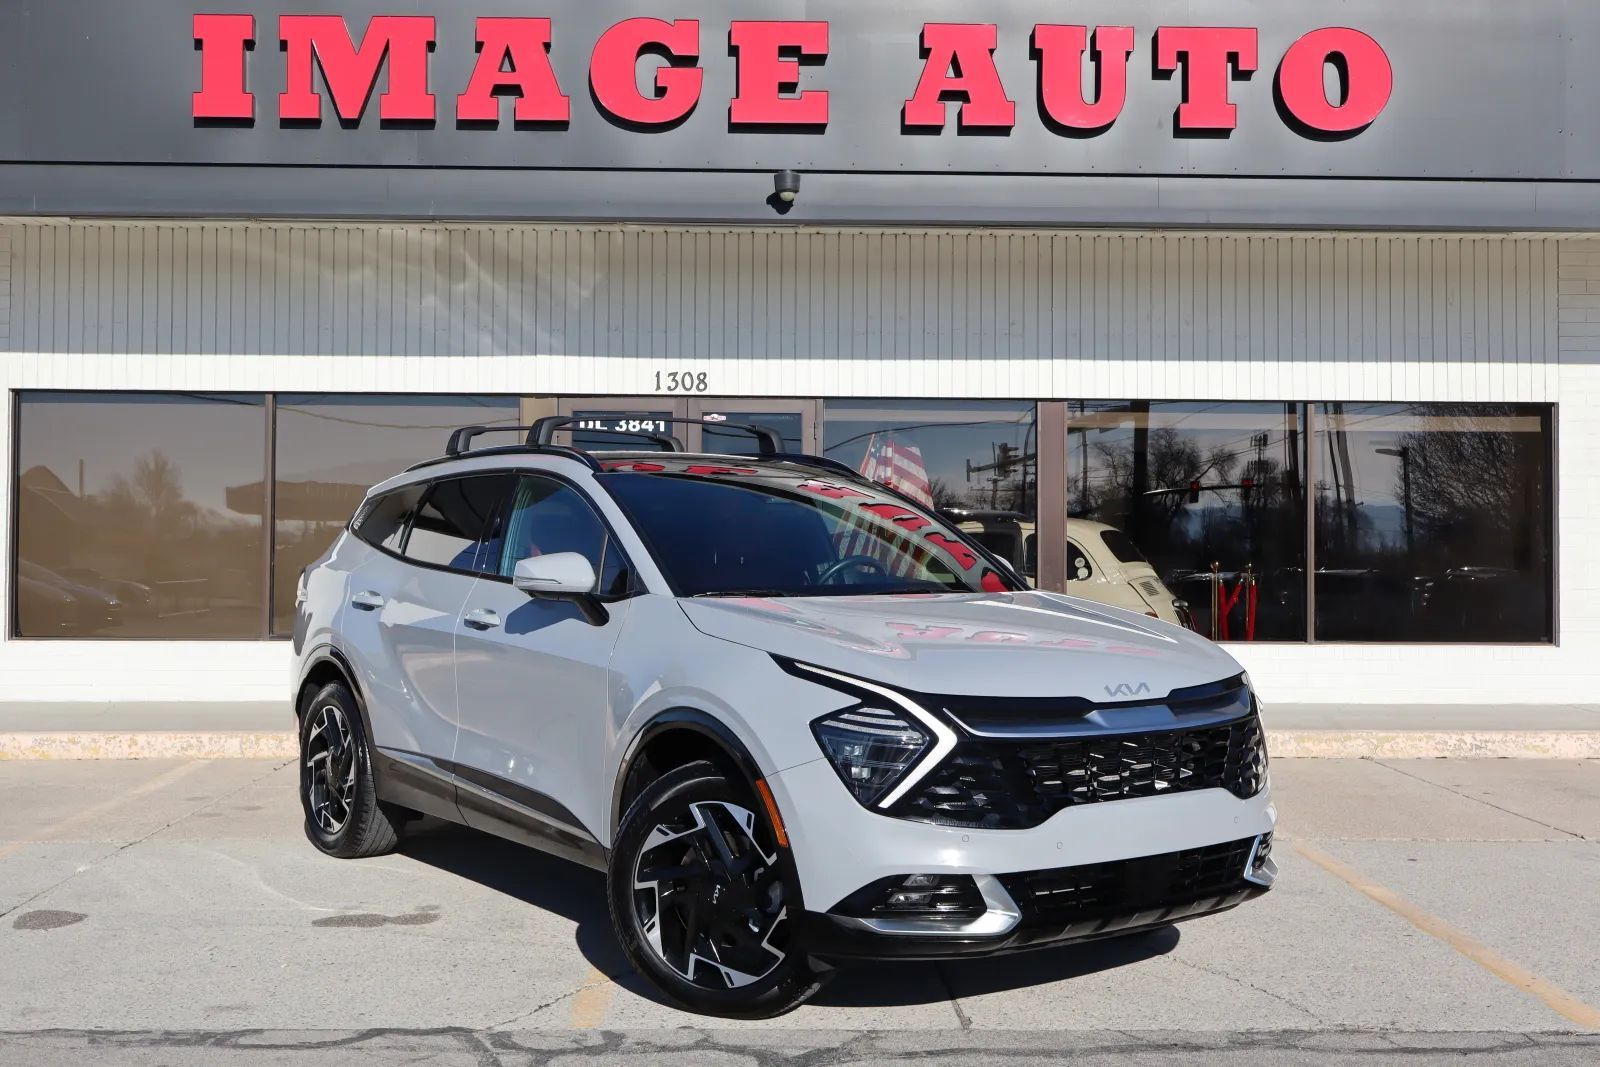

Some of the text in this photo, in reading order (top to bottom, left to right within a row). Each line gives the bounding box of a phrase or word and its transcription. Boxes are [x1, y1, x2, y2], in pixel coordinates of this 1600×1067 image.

[191, 14, 1393, 132] IMAGE AUTO
[655, 370, 708, 392] 1308
[614, 419, 665, 432] 3841
[1103, 682, 1151, 698] KIA
